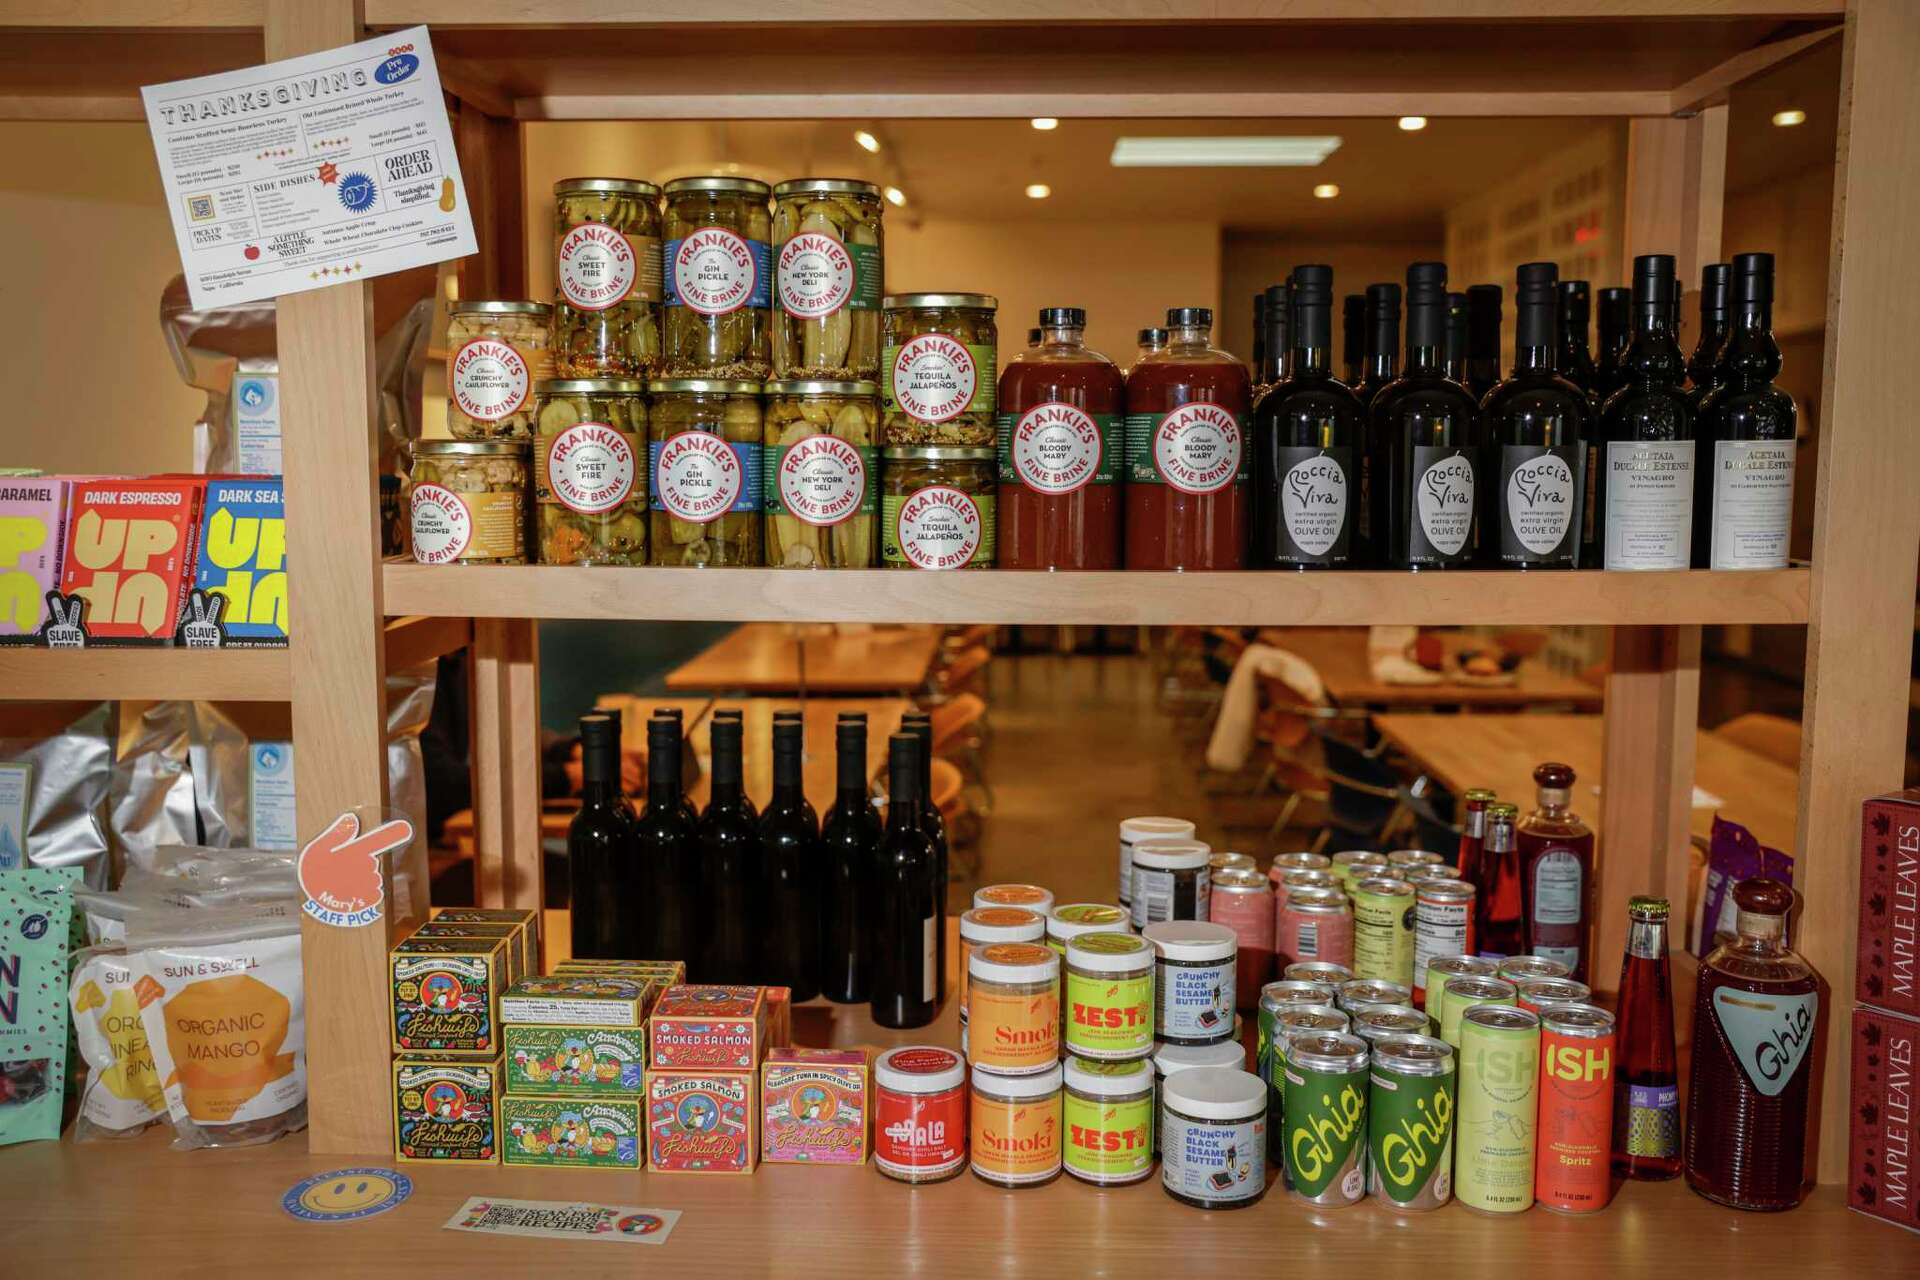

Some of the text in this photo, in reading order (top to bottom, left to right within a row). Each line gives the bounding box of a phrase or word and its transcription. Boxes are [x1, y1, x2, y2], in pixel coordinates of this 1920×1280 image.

[386, 59, 403, 70] Pre
[387, 63, 412, 81] Order
[159, 68, 367, 125] THANKSGIVING
[385, 90, 404, 100] Turkey
[266, 116, 287, 127] Turkey
[385, 149, 431, 170] ORDER
[388, 162, 433, 182] AHEAD
[253, 174, 316, 193] SIDE DISHES
[394, 182, 435, 197] Thanksgiving
[267, 237, 315, 252] SOMETHING
[562, 229, 630, 263] FRANKIE'S
[680, 233, 750, 268] FRANKIE'S
[781, 237, 848, 272] FRANKIE'S
[583, 269, 601, 277] FIRE
[698, 273, 729, 281] PICKLE
[792, 271, 807, 279] NEW
[566, 275, 624, 298] FINE BRINE
[684, 280, 745, 304] FINE BRINE
[785, 284, 841, 308] FINE BRINE
[457, 344, 523, 377] FRANKIE'S
[898, 340, 971, 374] FRANKIE'S
[910, 380, 957, 390] JALAPEÑOS
[914, 372, 951, 380] TEQUILA
[458, 391, 521, 416] FINE BRINE
[900, 389, 968, 416] FINE BRINE
[1019, 408, 1095, 444] FRANKIE'S
[1162, 408, 1237, 444] FRANKIE'S
[554, 429, 629, 464] FRANKIE'S
[662, 438, 735, 473] FRANKIE'S
[576, 463, 606, 471] SWEET
[786, 441, 860, 476] FRANKIE'S
[822, 476, 843, 484] YORK
[1024, 457, 1088, 483] FINE BRINE
[1168, 457, 1232, 482] FINE BRINE
[1289, 467, 1343, 492] Roccia
[1427, 466, 1472, 492] Roccia
[1515, 465, 1570, 492] Roccia
[560, 476, 624, 502] FINE BRINE
[680, 479, 712, 487] PICKLE
[0, 488, 52, 501] ARAMEL
[84, 491, 182, 505] DARK ESPRESSO
[218, 489, 279, 503] DARK SEA
[666, 486, 729, 511] FINE BRINE
[792, 489, 855, 514] FINE BRINE
[1292, 485, 1338, 509] Viva
[1429, 485, 1468, 509] Viva
[1518, 484, 1565, 508] Viva
[904, 492, 976, 525] FRANKIE'S
[916, 532, 964, 541] JALAPEÑOS
[921, 523, 958, 532] TEQUILA
[1295, 527, 1336, 535] OLIVE OIL
[1431, 527, 1454, 535] OLIVE
[1520, 526, 1562, 534] OLIVE OIL
[428, 537, 463, 563] BRINE
[907, 540, 973, 568] FINE BRINE
[49, 631, 80, 641] SLAVE
[186, 627, 217, 638] SLAVE
[318, 891, 365, 912] Mary's
[1893, 826, 1919, 998] MAPLE LEAVES
[305, 900, 378, 925] STAFF PICK
[165, 965, 194, 978] SUN
[198, 964, 207, 974] &
[1176, 971, 1220, 981] CRUNCHY
[1175, 989, 1213, 998] SESAME
[1176, 981, 1207, 989] BLACK
[1175, 998, 1211, 1006] BUTTER
[177, 1013, 265, 1037] ORGANIC
[407, 1013, 479, 1037] Fishwife
[188, 1040, 260, 1060] MANGO
[656, 1035, 751, 1045] SMOKED SALMON
[1755, 1003, 1812, 1081] Ghia
[1476, 1048, 1538, 1083] ISH
[1546, 1044, 1610, 1082] ISH
[658, 1081, 740, 1099] SMOKED SALMON
[768, 1076, 795, 1086] ALBACORE
[797, 1072, 811, 1080] TUNA
[820, 1073, 836, 1082] SPICY
[837, 1079, 851, 1088] OLIVE
[583, 1104, 635, 1131] Anchovies
[1885, 1038, 1911, 1209] MAPLE LEAVES
[410, 1121, 484, 1147] Fishwife
[1186, 1136, 1219, 1148] BLACK
[1187, 1127, 1236, 1139] CRUNCHY
[1292, 1084, 1364, 1182] Ghia
[1382, 1086, 1453, 1186] Ghia
[662, 1134, 736, 1158] Fishwife
[1186, 1146, 1226, 1157] SESAME
[1186, 1155, 1223, 1166] BUTTER
[1559, 1155, 1592, 1166] Spritz
[522, 1214, 598, 1223] DELICIOUS
[528, 1209, 601, 1218] SCAN FOR
[518, 1220, 594, 1230] RECIPES
